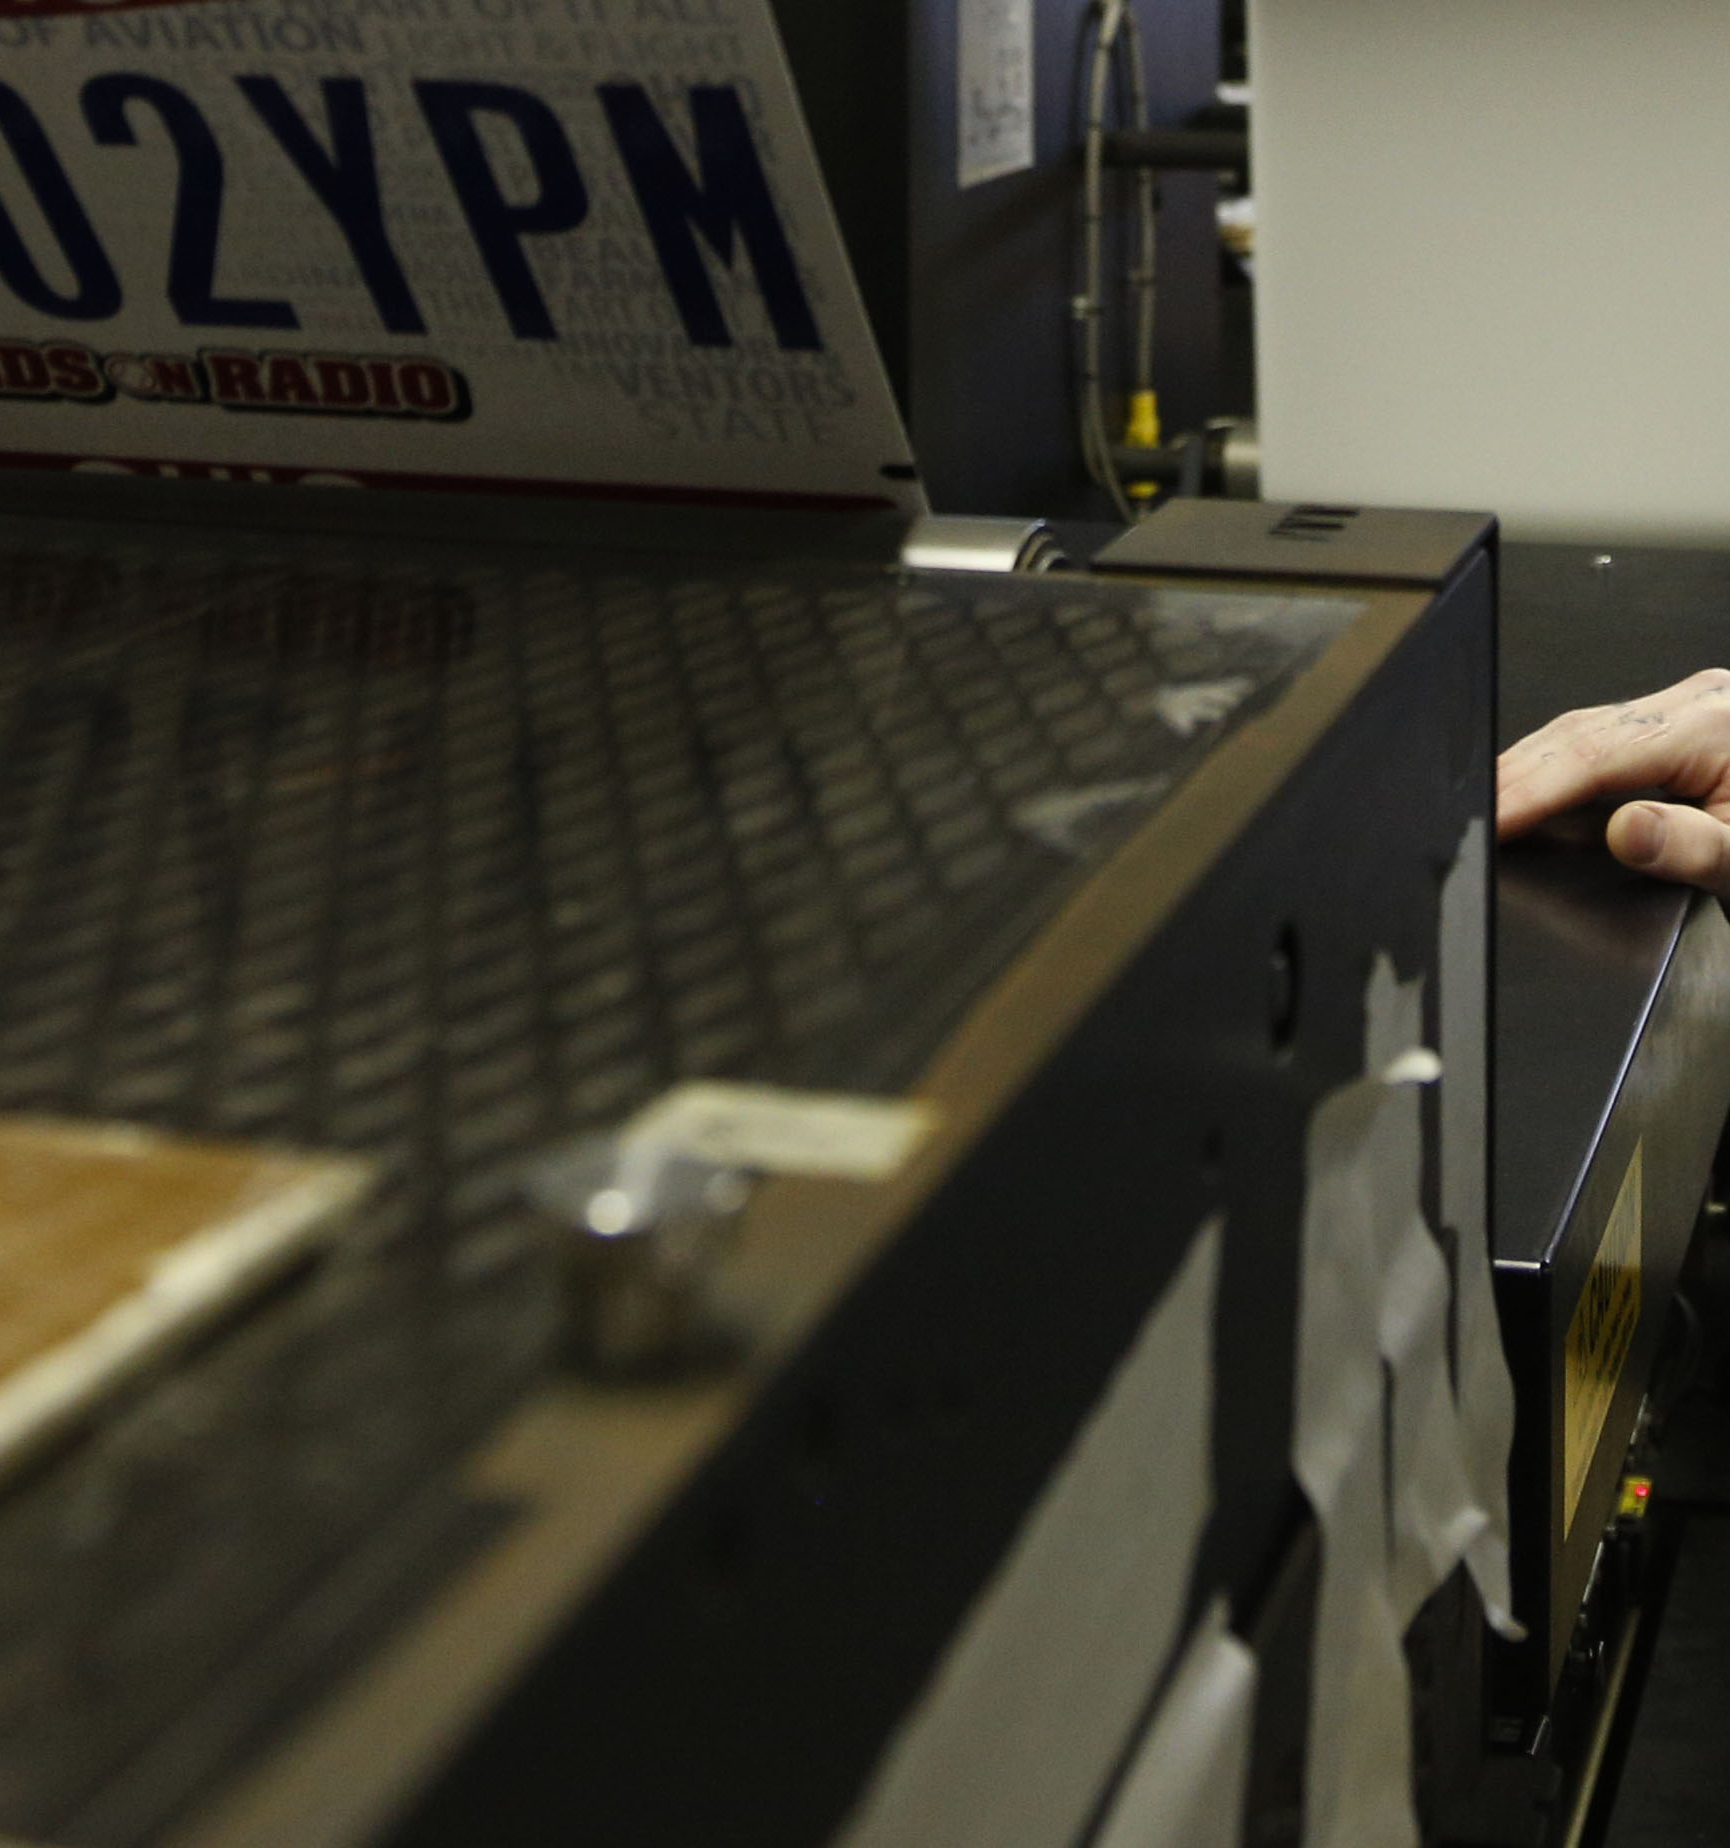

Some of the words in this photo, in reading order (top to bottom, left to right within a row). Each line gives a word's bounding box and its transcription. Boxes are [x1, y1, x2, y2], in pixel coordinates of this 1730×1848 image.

[77, 14, 363, 52] AVIATION
[208, 352, 458, 412] RADIO
[636, 402, 836, 447] STATE
